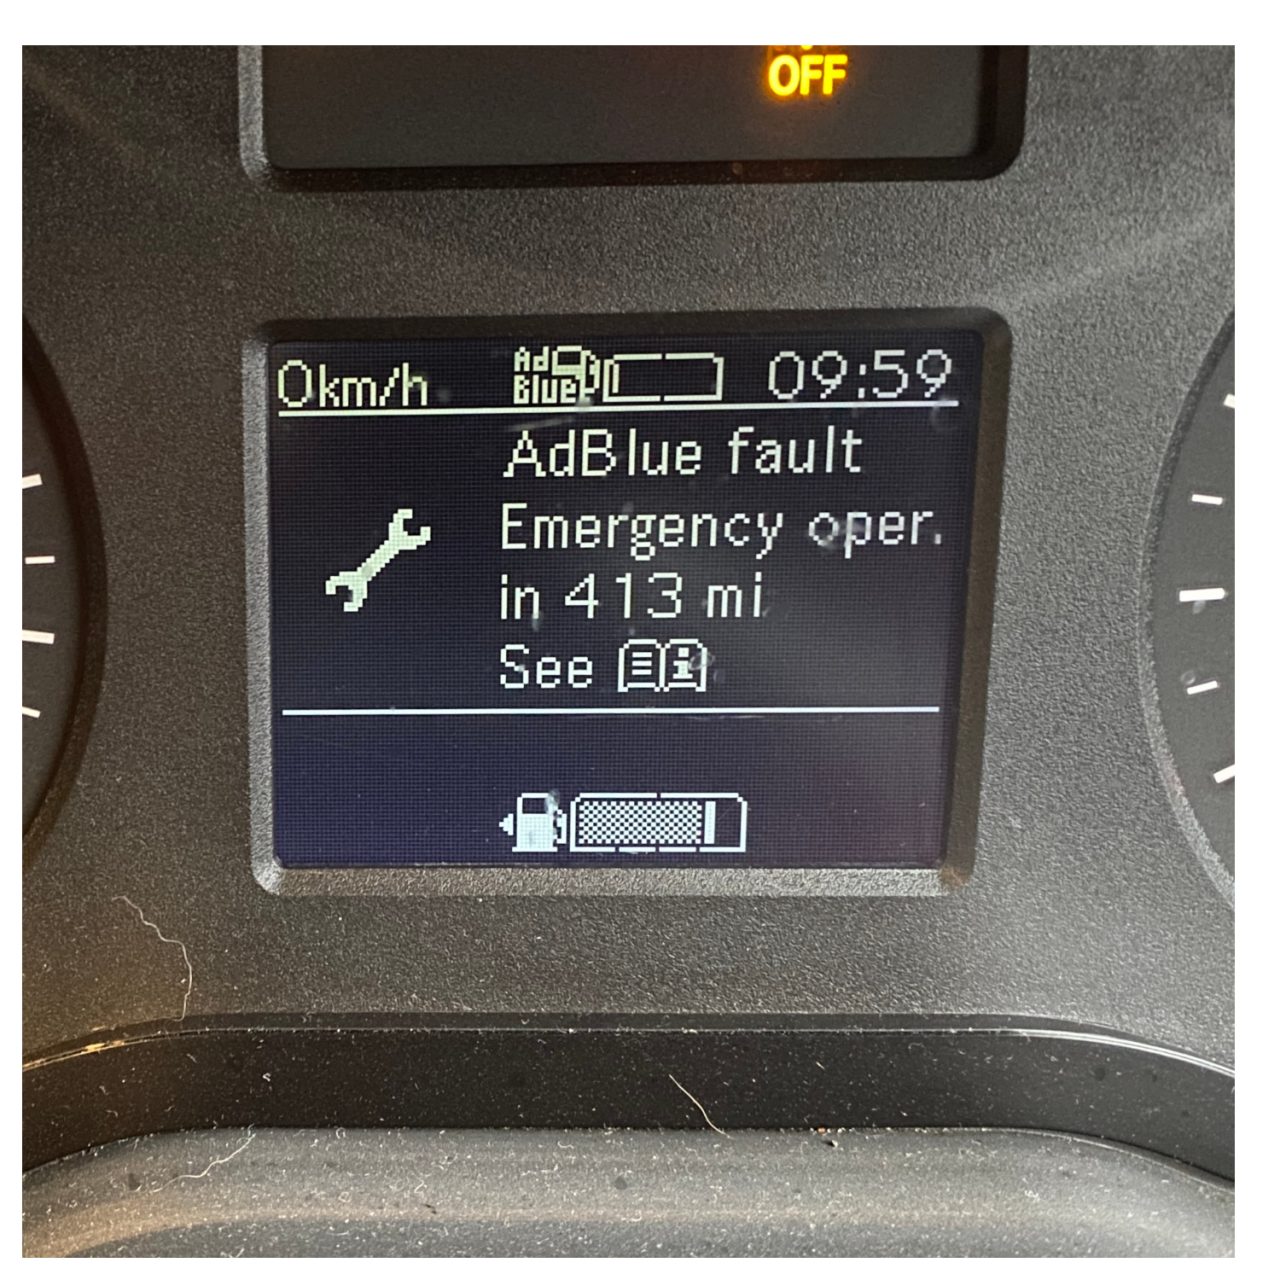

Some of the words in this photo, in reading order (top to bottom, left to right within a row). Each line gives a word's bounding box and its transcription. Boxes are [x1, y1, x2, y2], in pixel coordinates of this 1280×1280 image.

[768, 54, 848, 96] OFF
[514, 345, 549, 371] Ad
[768, 349, 953, 400] 09:59
[277, 359, 428, 407] 0km/h
[513, 374, 576, 404] Blue
[502, 428, 703, 478] AdBlue
[728, 426, 863, 476] fault
[501, 501, 783, 560] Emergency
[807, 508, 944, 558] oper.
[500, 575, 541, 619] in
[563, 571, 684, 620] 413
[707, 572, 764, 618] mi
[500, 645, 595, 689] See
